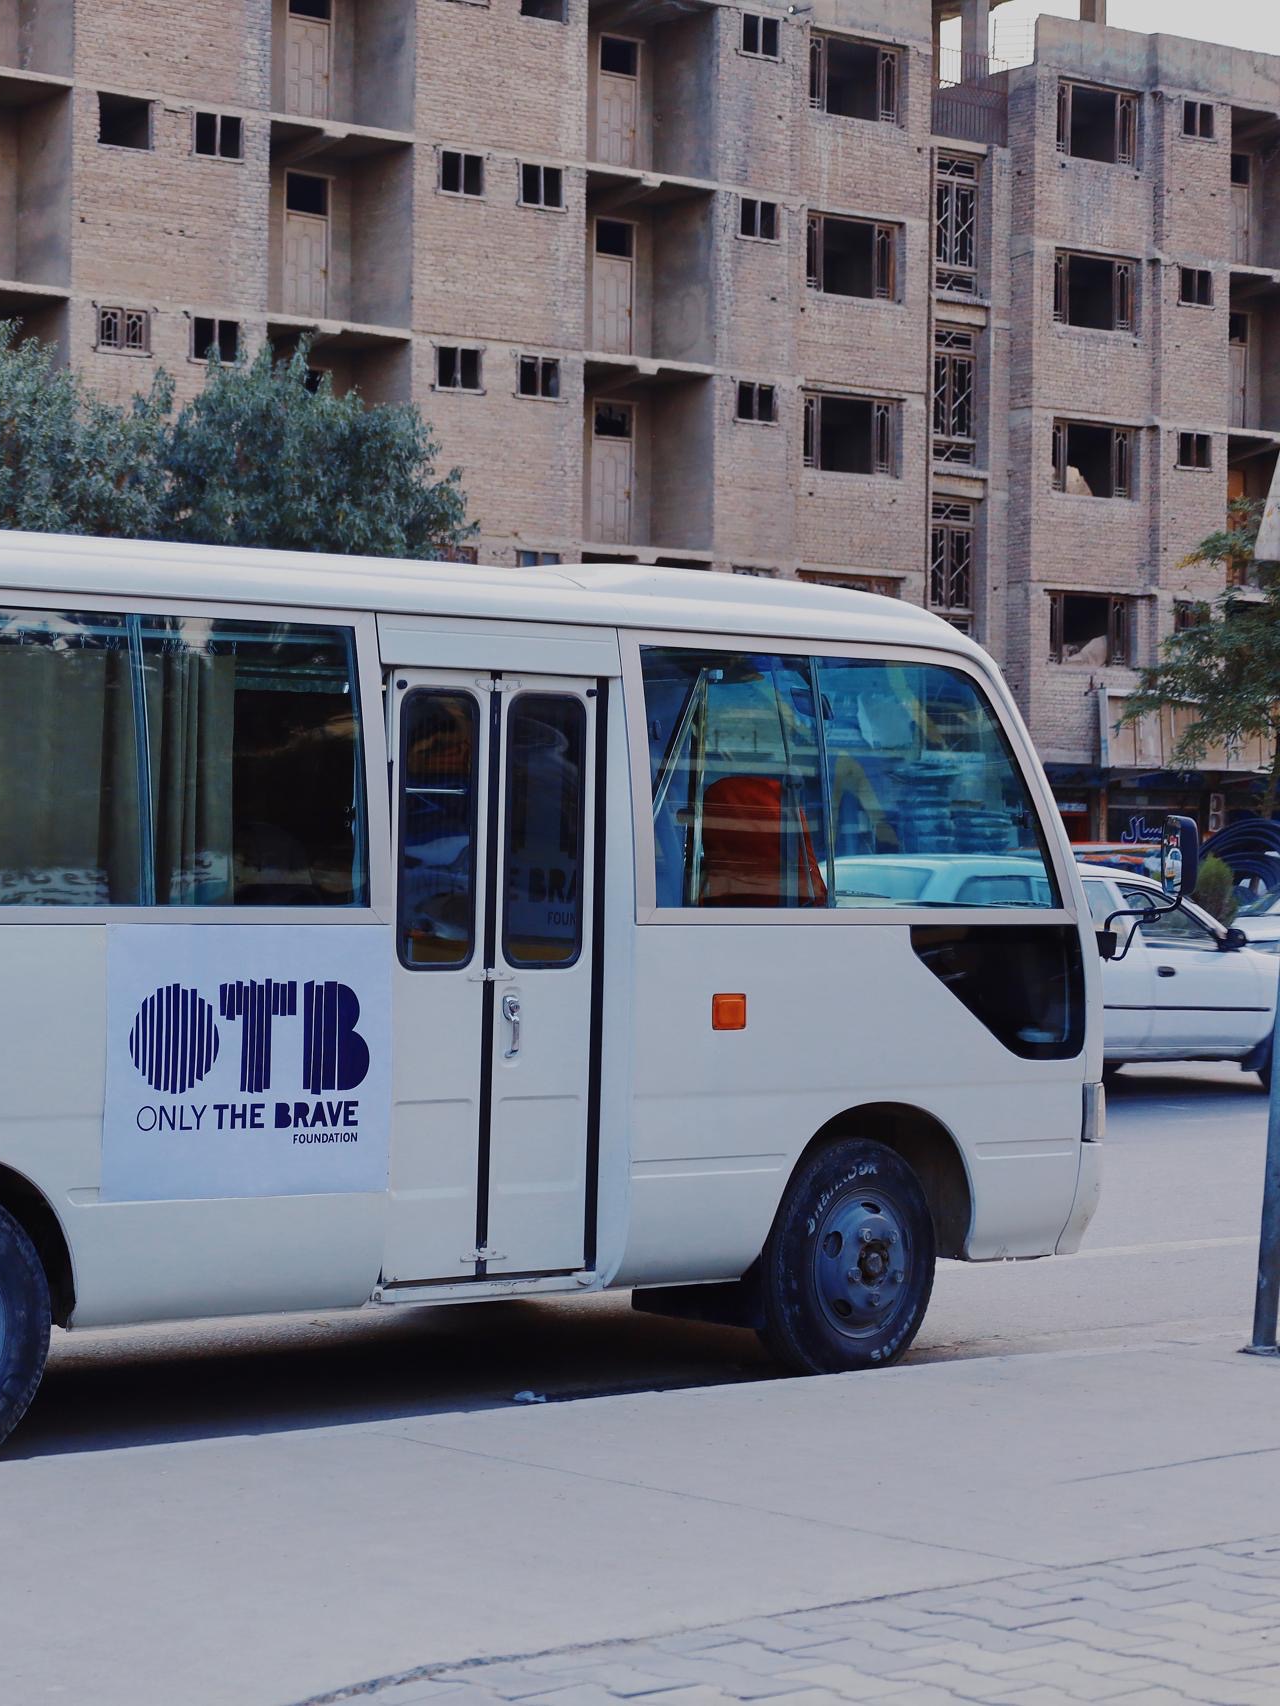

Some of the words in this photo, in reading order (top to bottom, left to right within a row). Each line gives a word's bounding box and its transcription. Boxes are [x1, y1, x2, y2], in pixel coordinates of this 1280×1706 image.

[129, 978, 370, 1095] OTB
[136, 1104, 208, 1131] ONLY
[213, 1103, 266, 1130] THE
[274, 1100, 359, 1128] BRAVE
[292, 1132, 358, 1144] FOUNDATION
